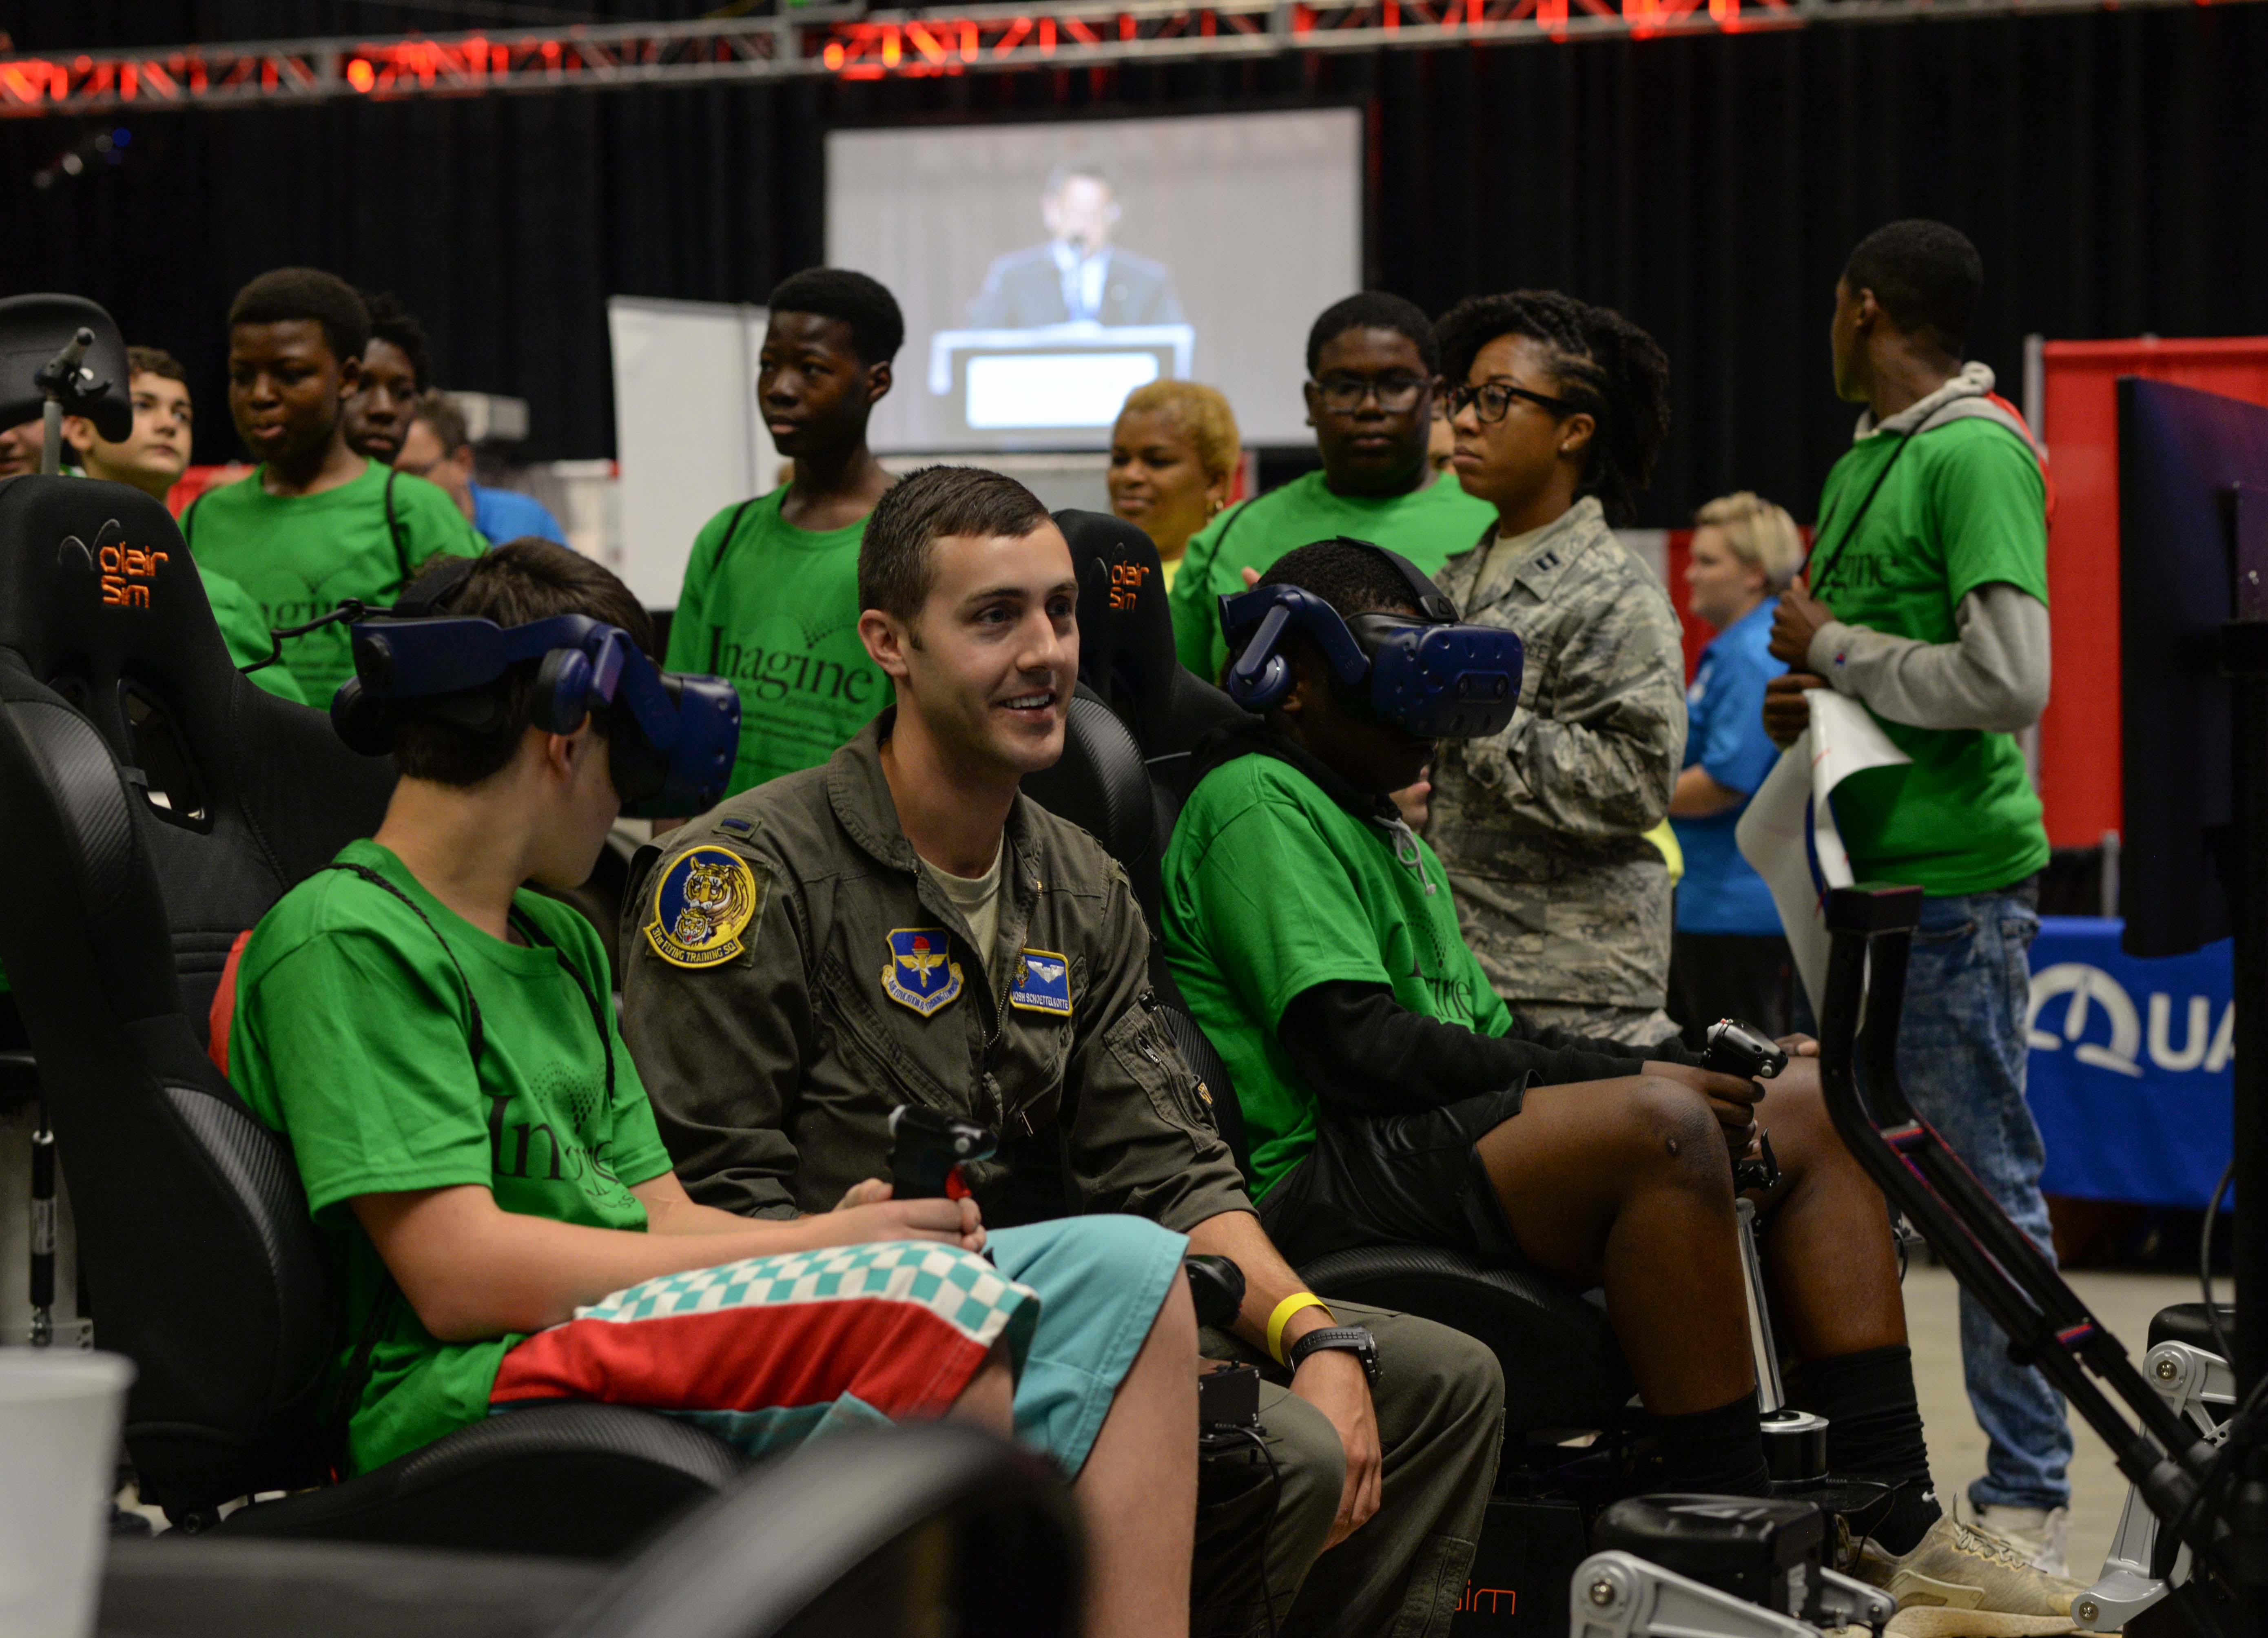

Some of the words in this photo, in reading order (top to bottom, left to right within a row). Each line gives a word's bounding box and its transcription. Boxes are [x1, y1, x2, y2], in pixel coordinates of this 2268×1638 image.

[662, 940, 684, 960] FLYING
[686, 948, 723, 962] TRAINING
[894, 988, 920, 1007] EDUCATION
[919, 1001, 924, 1010] &
[1012, 991, 1025, 1002] JOSH
[1455, 1579, 1516, 1615] im
